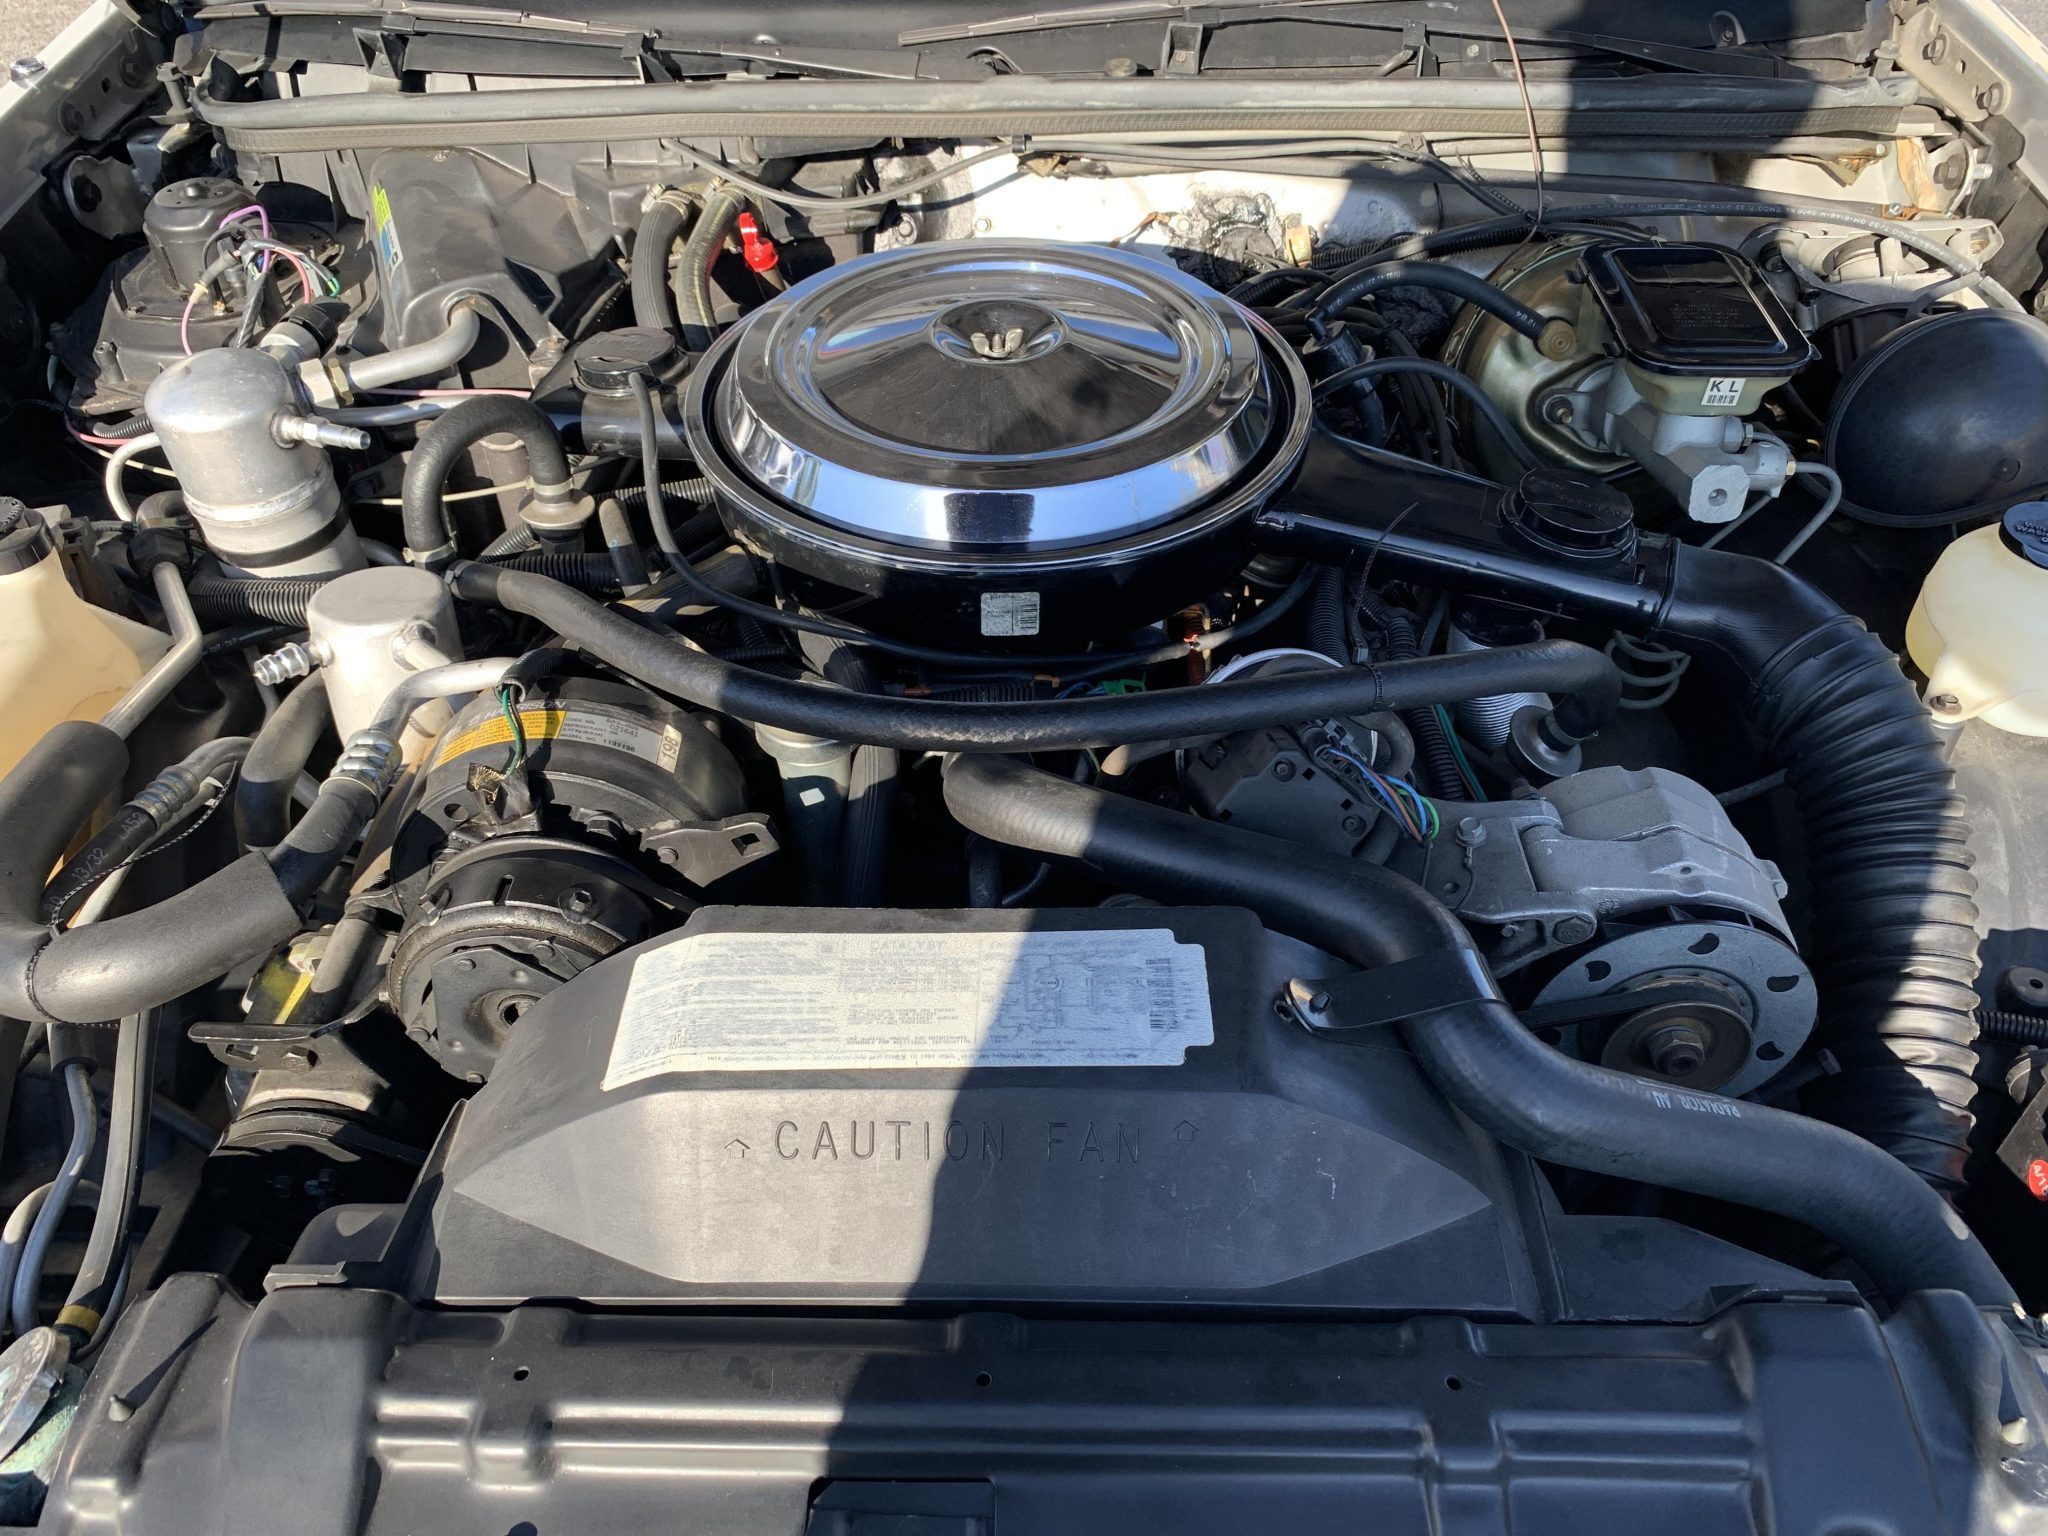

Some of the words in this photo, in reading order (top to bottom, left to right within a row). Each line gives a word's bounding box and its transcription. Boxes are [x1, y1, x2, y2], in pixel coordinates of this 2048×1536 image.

[71, 847, 110, 882] 13/32
[1676, 1094, 1742, 1119] RADIATOR
[773, 1119, 1005, 1162] CAUTION
[1046, 1120, 1142, 1164] FAN
